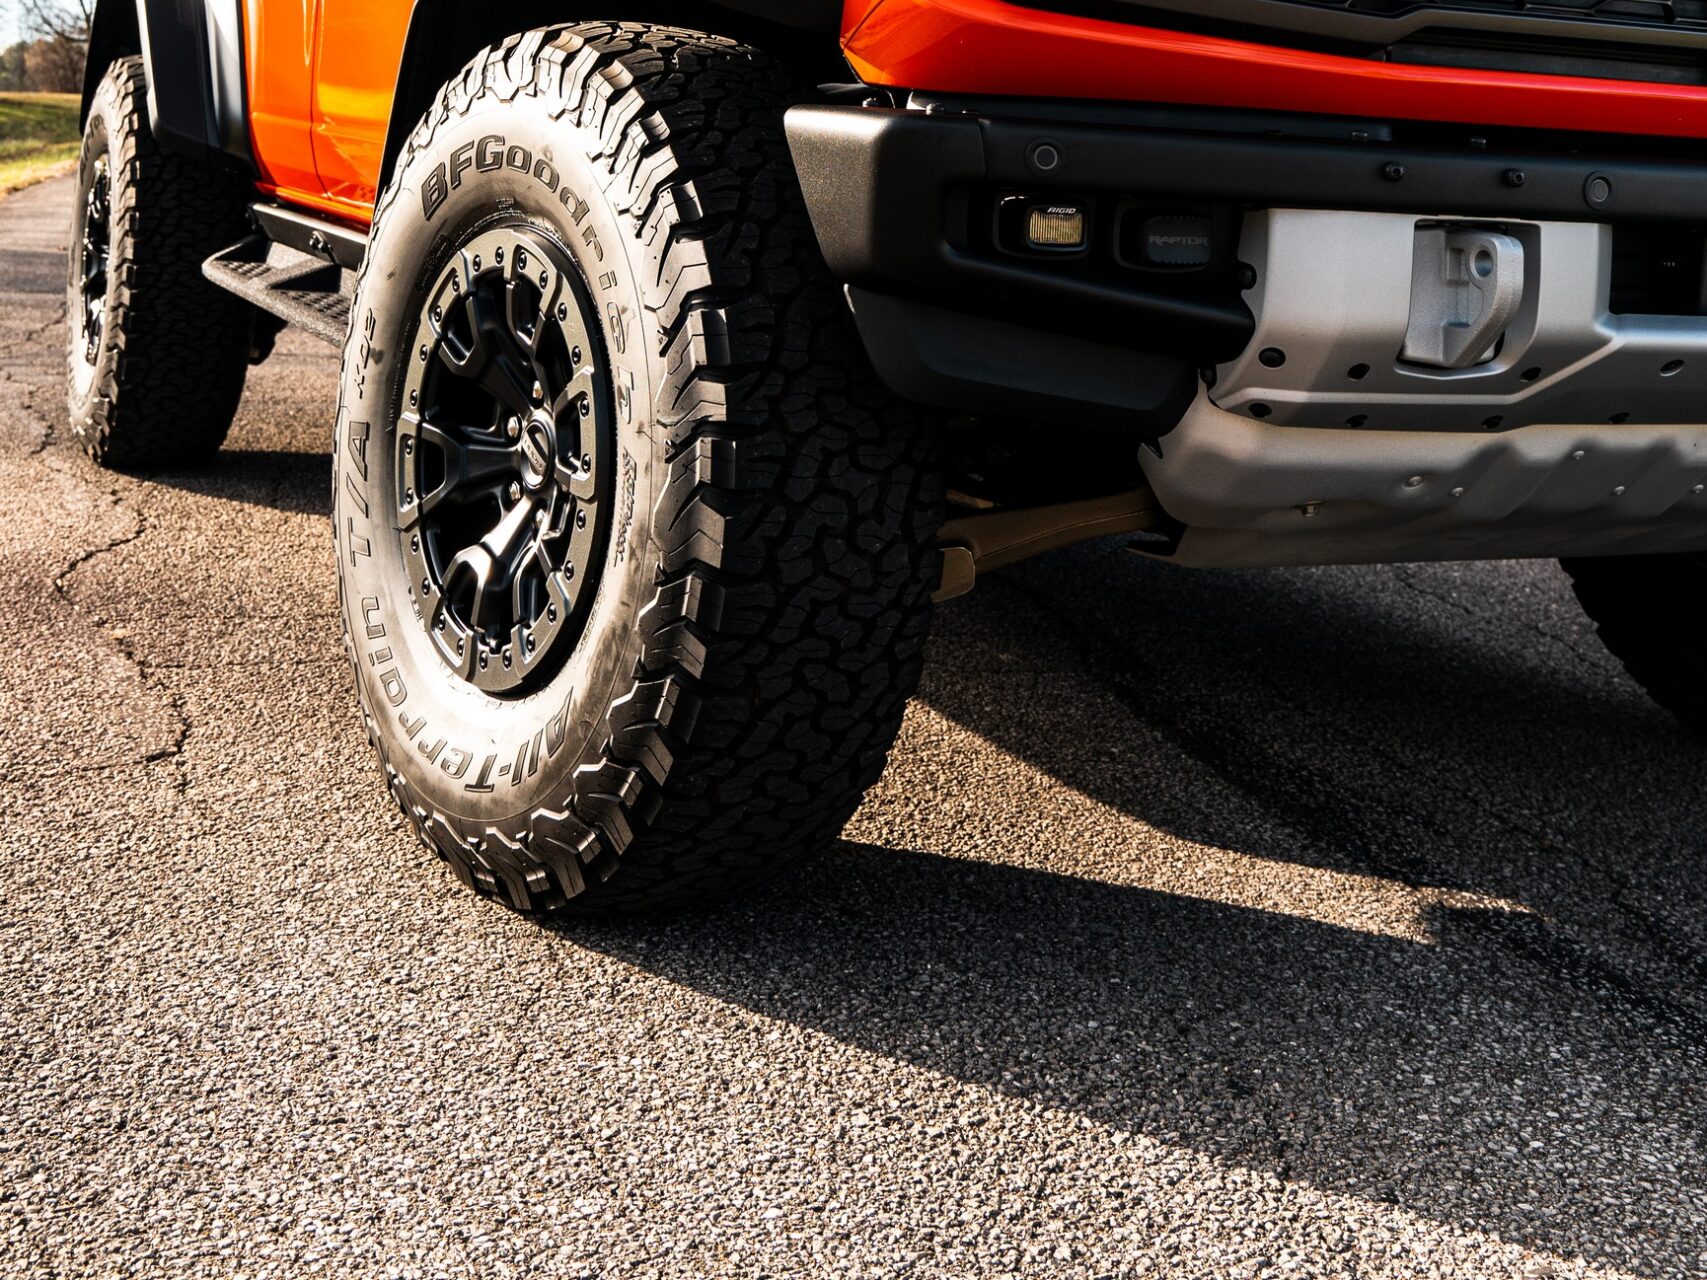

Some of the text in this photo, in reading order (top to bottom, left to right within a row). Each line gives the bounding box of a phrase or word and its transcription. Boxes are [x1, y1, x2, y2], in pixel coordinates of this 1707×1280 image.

[421, 134, 634, 424] BFGoodrich
[1149, 235, 1209, 246] RAPTOR
[346, 421, 371, 567] T/A
[361, 596, 574, 793] All-Terrain
